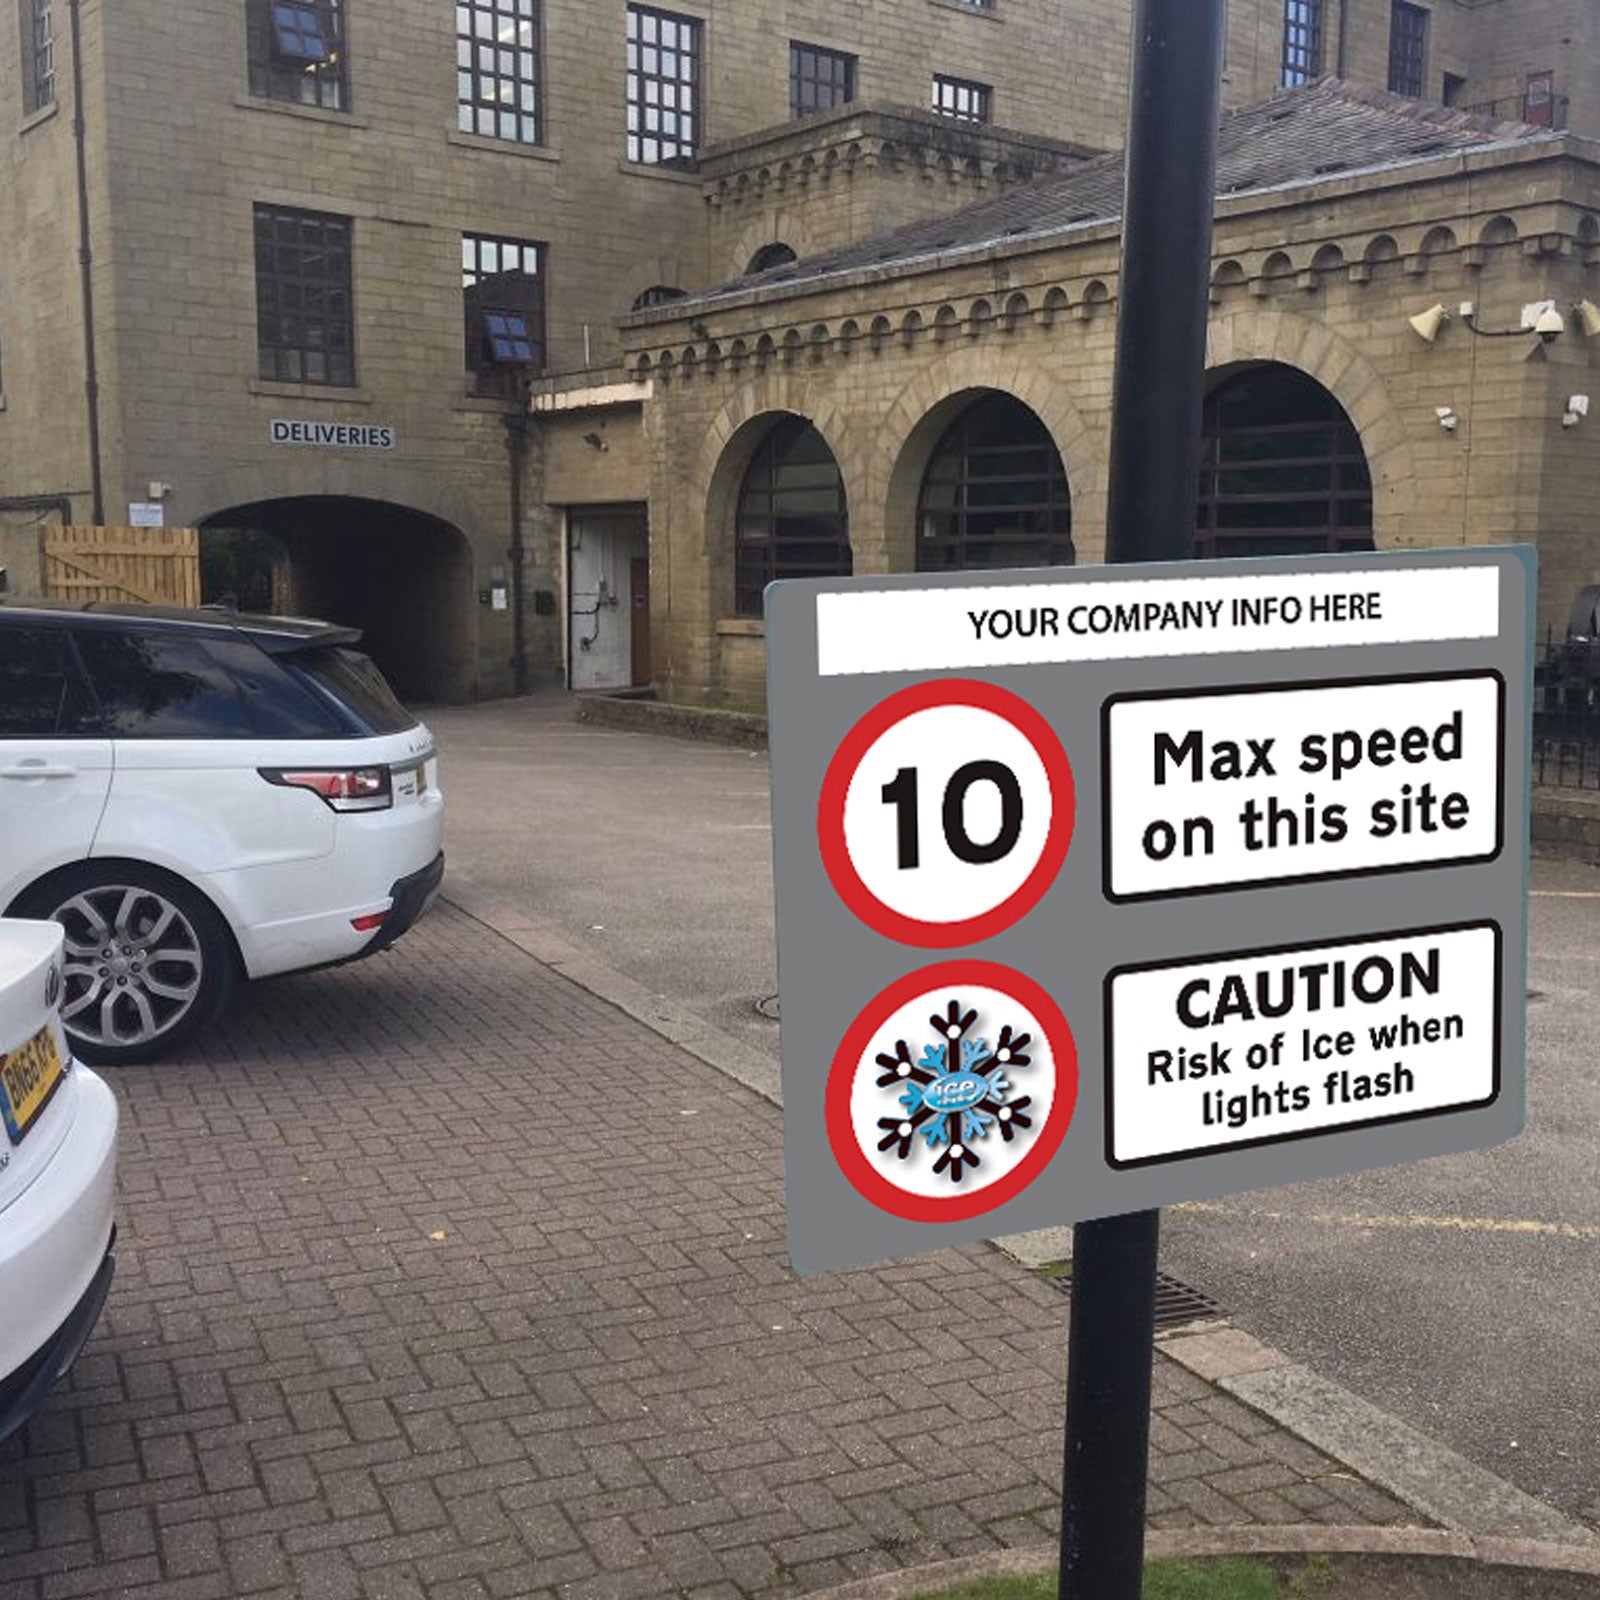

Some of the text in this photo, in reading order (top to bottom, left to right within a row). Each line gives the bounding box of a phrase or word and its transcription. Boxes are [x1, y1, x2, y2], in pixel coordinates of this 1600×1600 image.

[274, 423, 391, 447] DELIVERIES
[967, 593, 1382, 640] YOUR COMPANY INFO HERE
[1154, 711, 1463, 786] Max speed
[881, 760, 1024, 870] 10
[1142, 784, 1470, 861] on this site
[1176, 949, 1440, 1028] CAUTION
[1148, 1015, 1463, 1085] Risk of Ice when
[1204, 1063, 1414, 1127] lights flash
